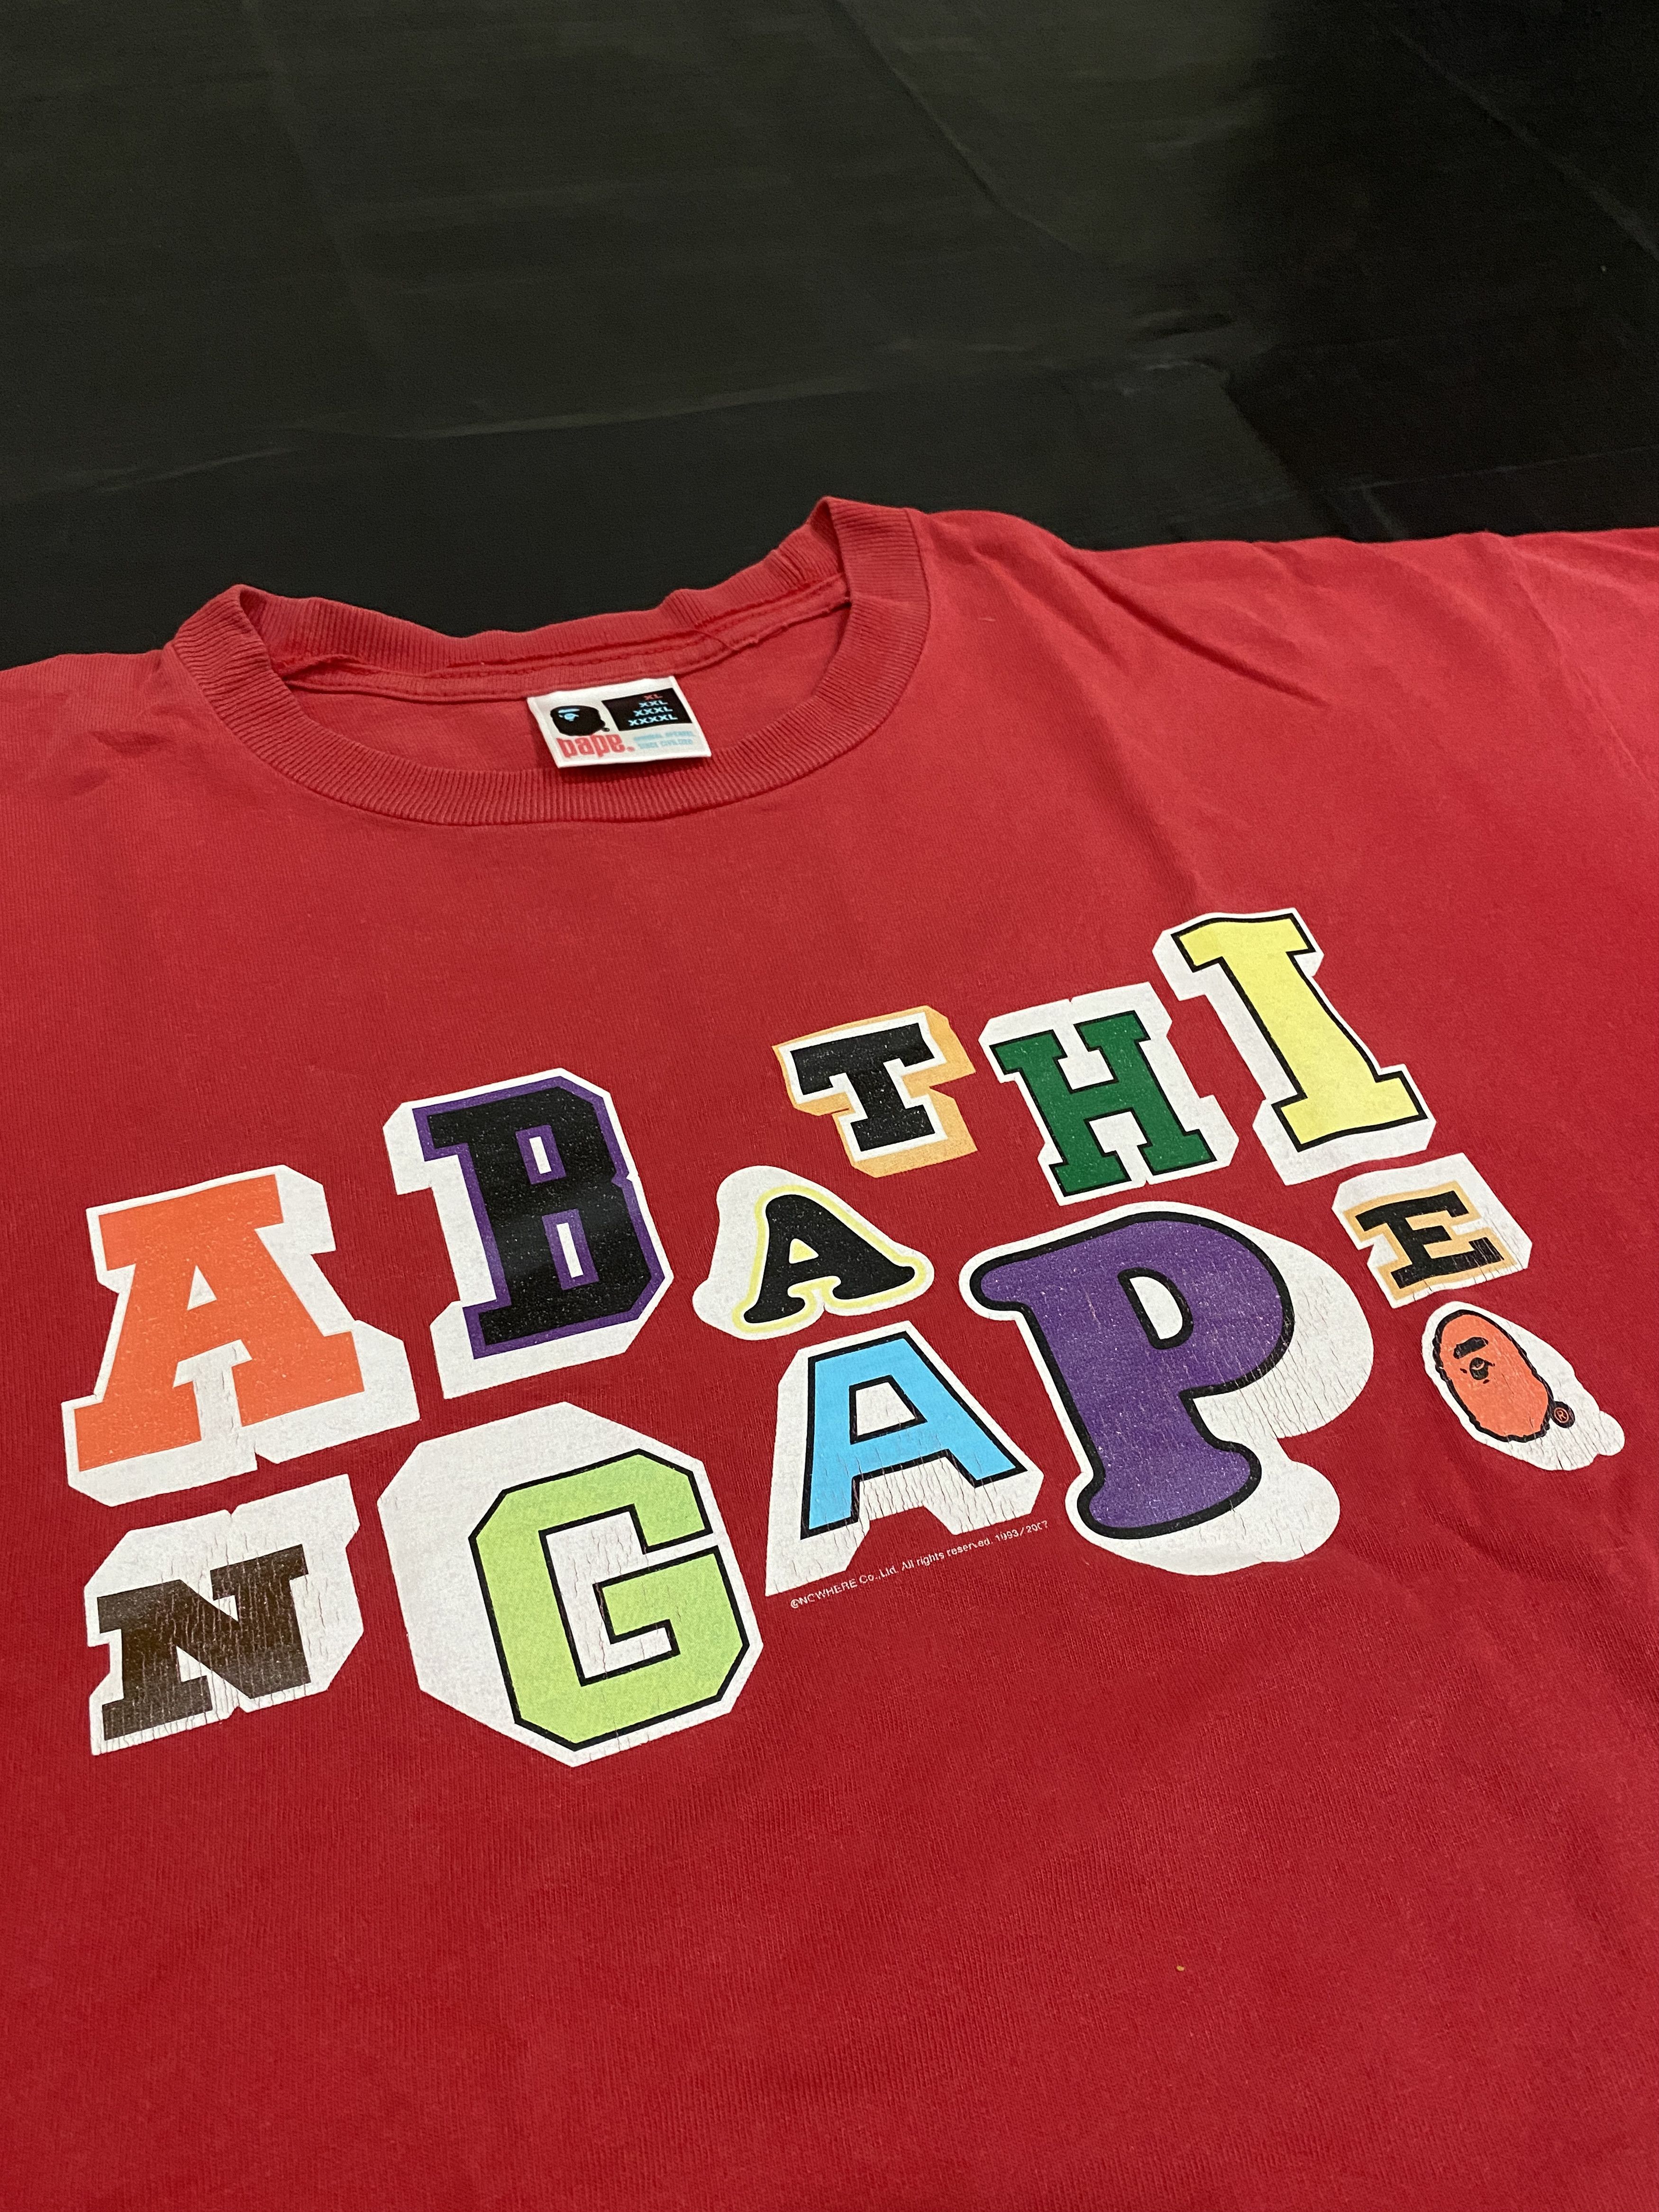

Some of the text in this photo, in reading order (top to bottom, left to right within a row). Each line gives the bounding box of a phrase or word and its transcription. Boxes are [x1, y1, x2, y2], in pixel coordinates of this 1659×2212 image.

[628, 714, 678, 726] XXXXL
[633, 707, 673, 717] XXXL
[71, 1171, 374, 1481] A
[902, 1560, 915, 1571] All
[916, 1551, 945, 1566] rights
